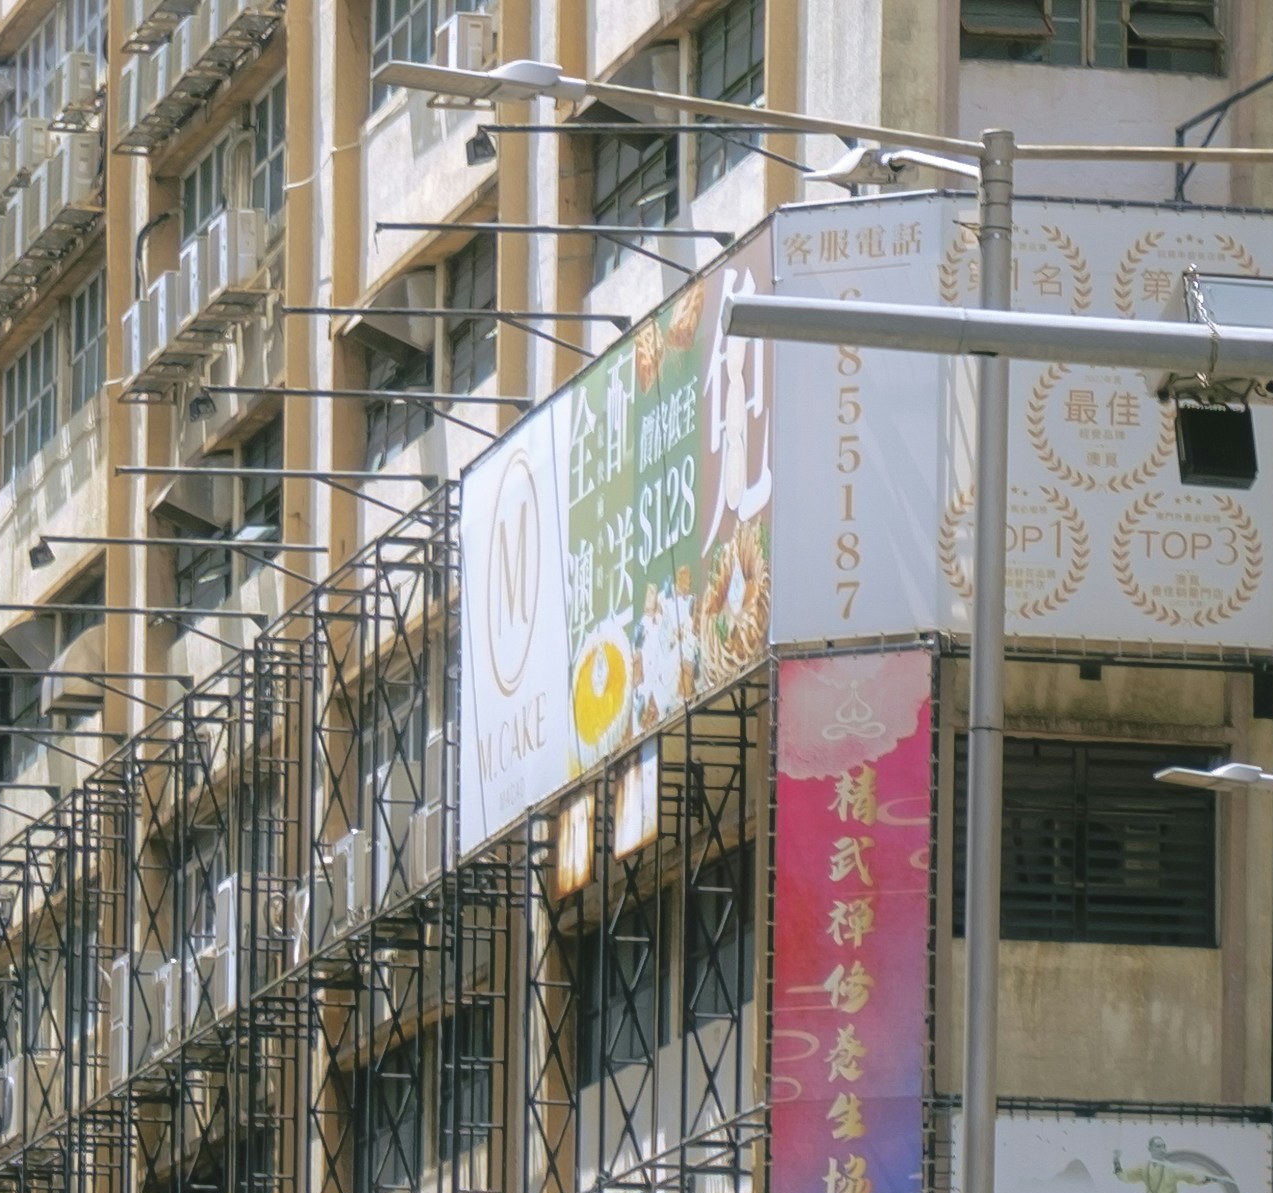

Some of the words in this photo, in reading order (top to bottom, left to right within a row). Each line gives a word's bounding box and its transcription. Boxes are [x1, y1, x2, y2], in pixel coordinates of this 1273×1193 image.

[783, 221, 922, 266] 客服電話
[1064, 389, 1141, 427] 最佳
[639, 455, 696, 575] $128
